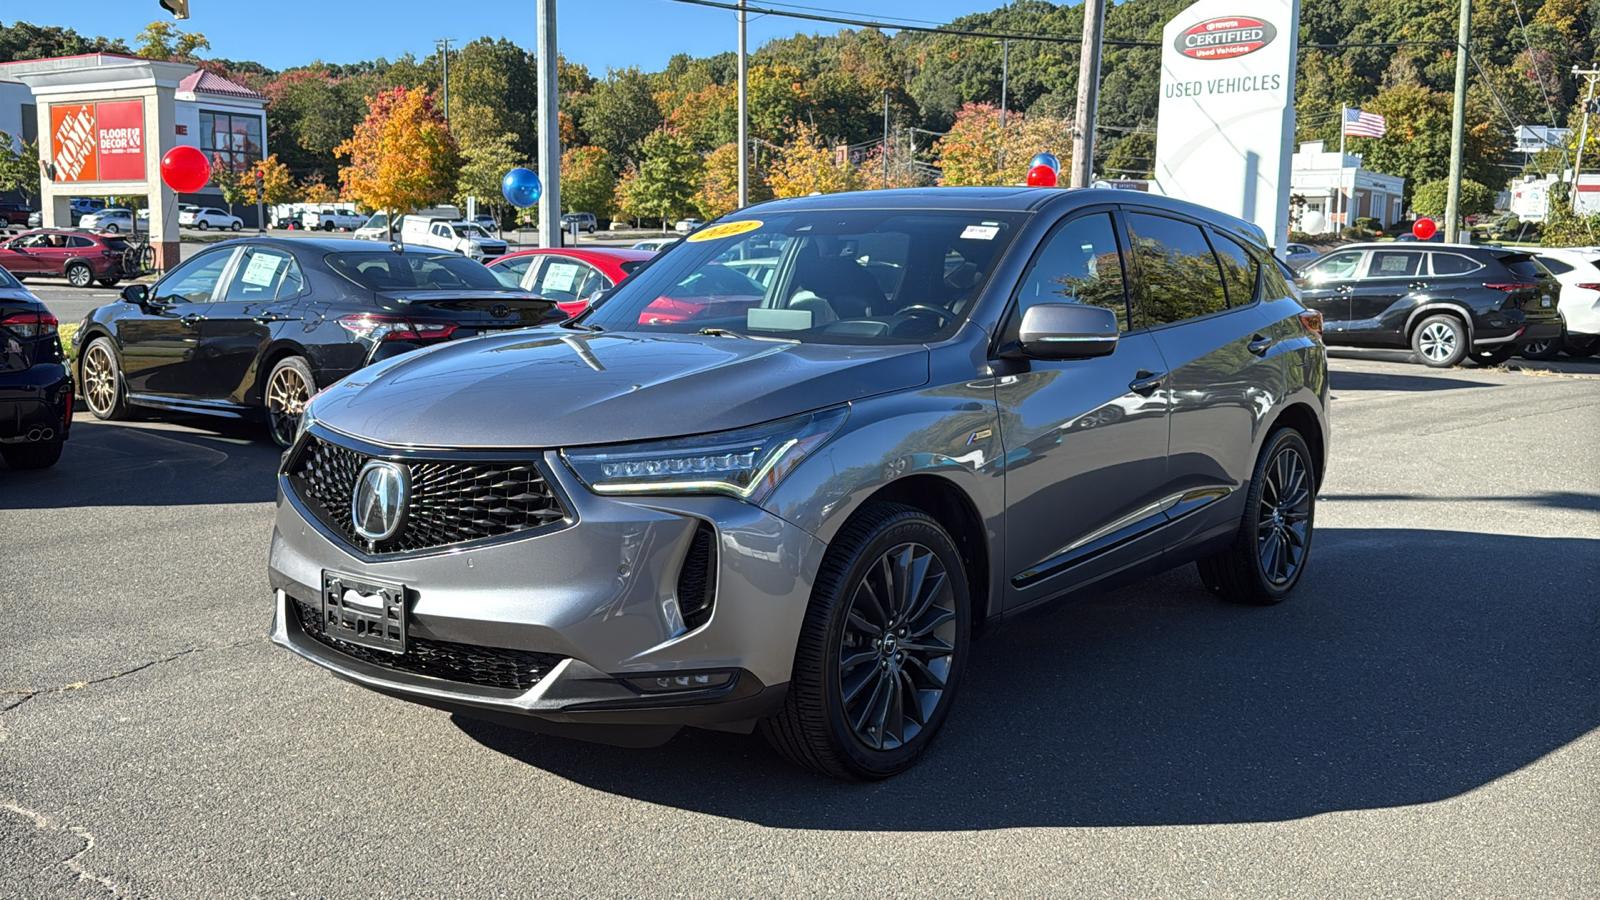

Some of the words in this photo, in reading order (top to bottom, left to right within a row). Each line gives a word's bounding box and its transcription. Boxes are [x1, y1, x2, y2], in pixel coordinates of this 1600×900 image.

[1215, 21, 1238, 29] TOYOTA
[1185, 29, 1263, 47] CERTIFIED
[1196, 49, 1215, 57] Used
[1216, 45, 1249, 55] Vehicles
[1165, 81, 1203, 99] USED
[1207, 74, 1280, 95] VEHICLES
[55, 110, 76, 144] THE
[54, 105, 95, 181] HOME
[100, 128, 127, 139] FLOOR
[127, 128, 140, 148] &
[100, 139, 127, 149] DECOR
[69, 131, 96, 181] DEPOT
